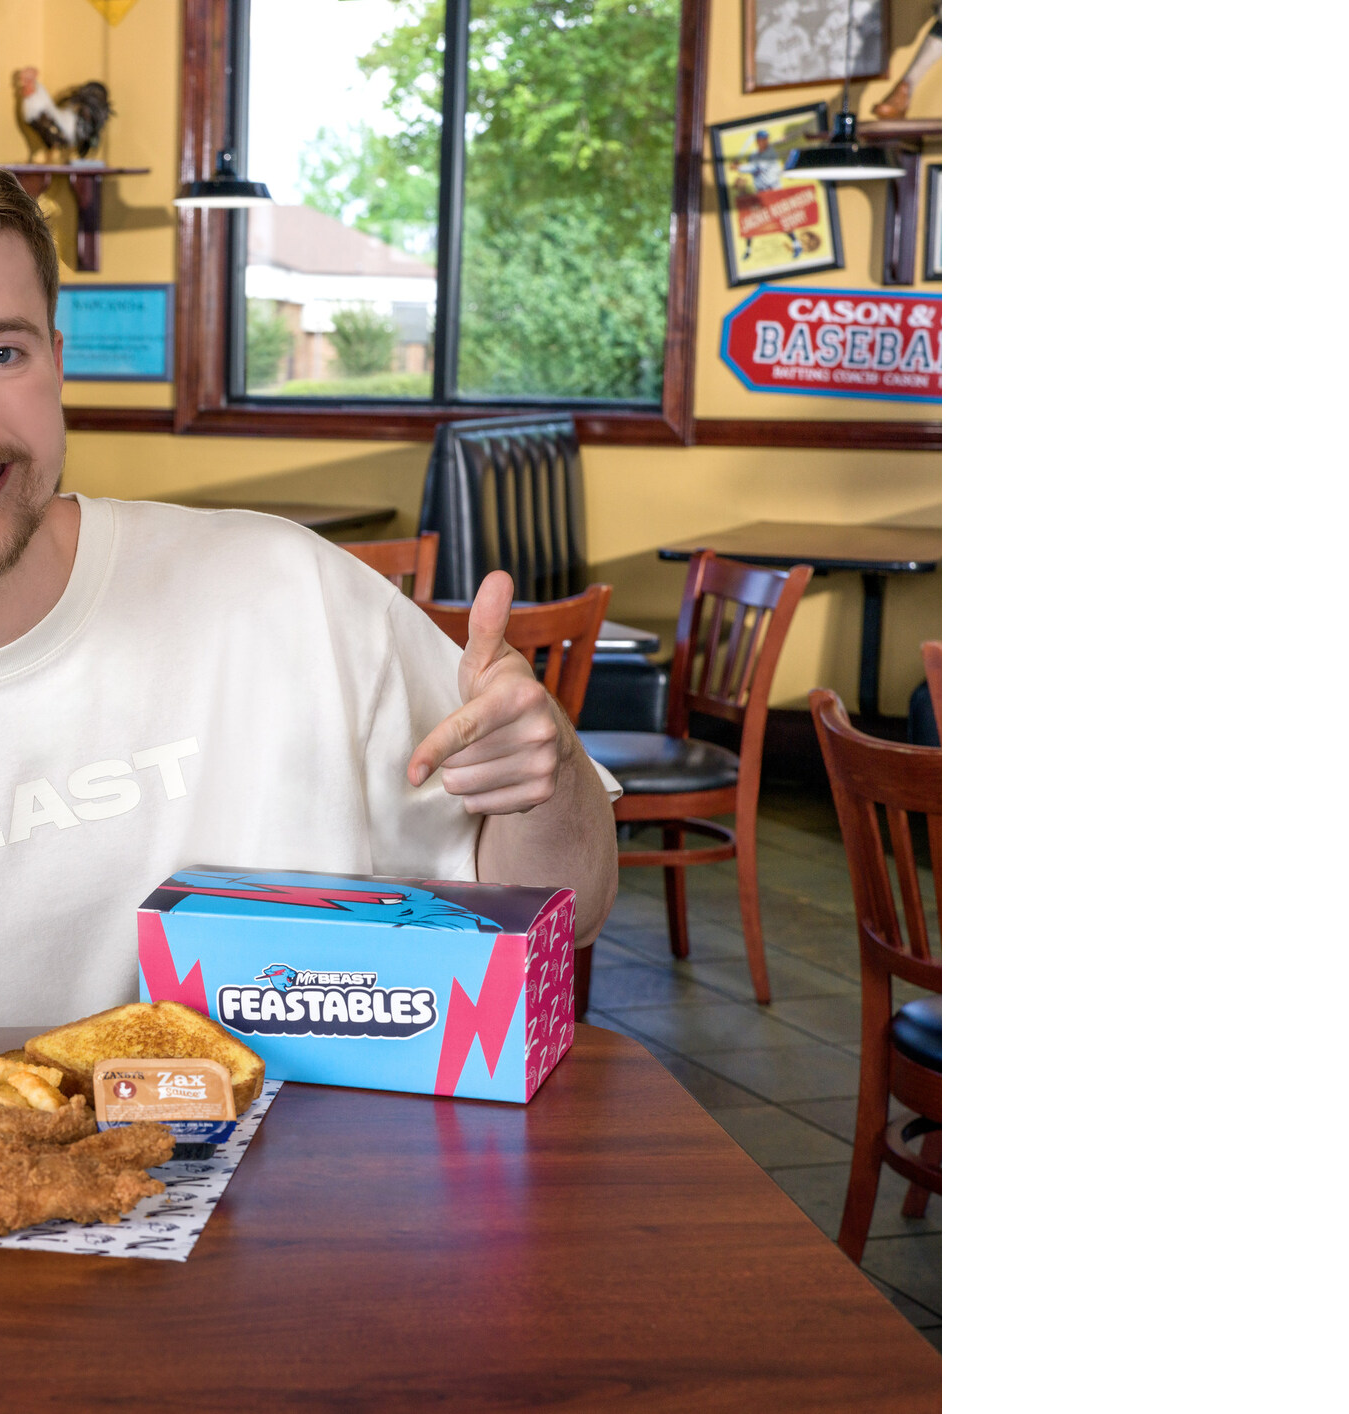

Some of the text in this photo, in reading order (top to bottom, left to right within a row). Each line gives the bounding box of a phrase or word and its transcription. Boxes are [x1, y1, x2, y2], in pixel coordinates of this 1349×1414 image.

[787, 298, 936, 328] CASON &
[220, 987, 435, 1026] FEASTABLES
[157, 1072, 206, 1087] Zax
